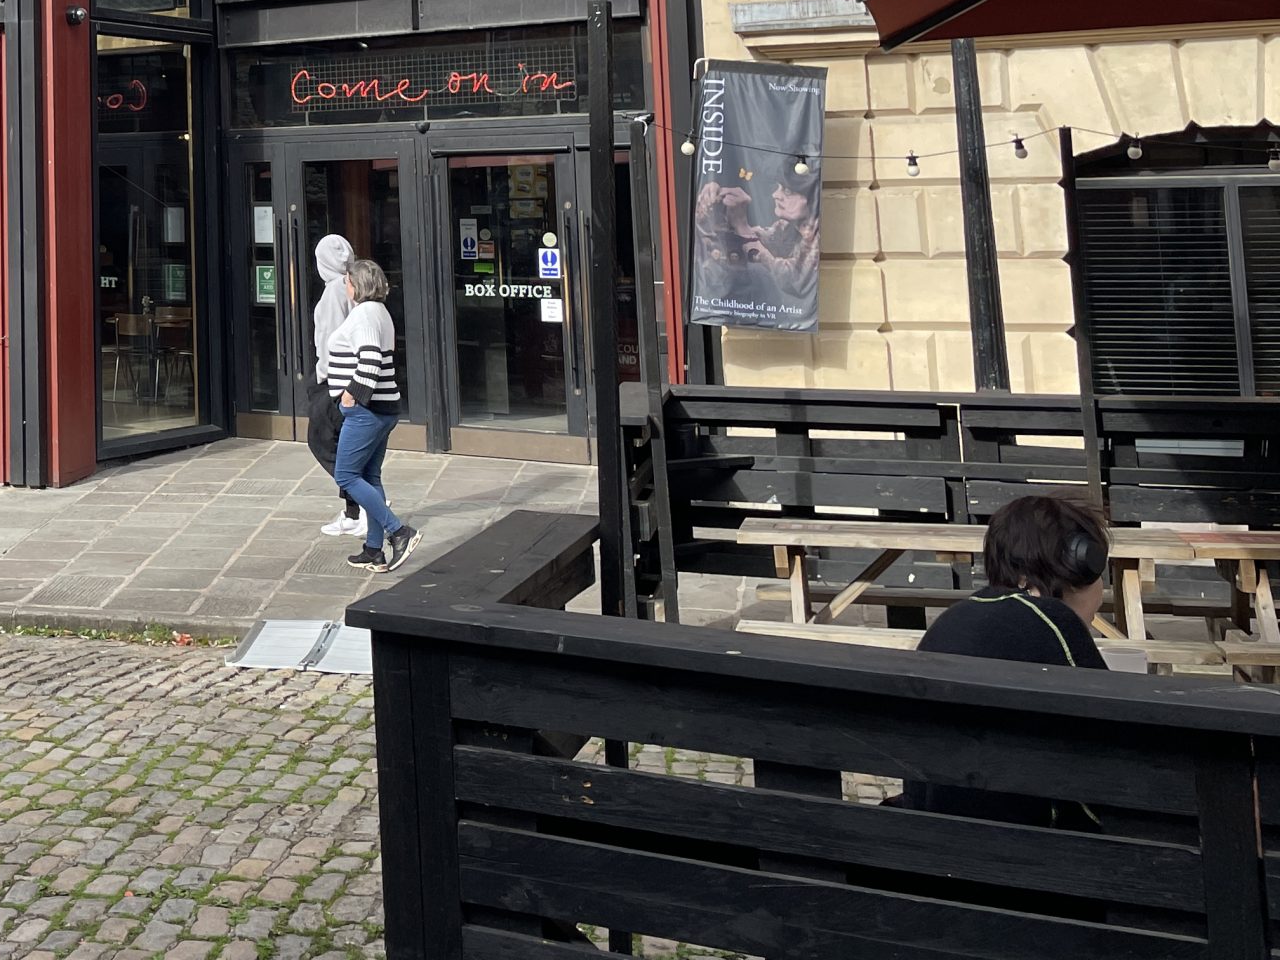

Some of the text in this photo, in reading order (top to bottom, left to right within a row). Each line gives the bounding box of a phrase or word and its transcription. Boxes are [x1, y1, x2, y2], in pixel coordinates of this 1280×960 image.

[290, 62, 575, 104] Come on in
[702, 77, 726, 176] INSIDE
[464, 283, 553, 298] BOX OFFICE
[694, 295, 709, 306] The
[710, 297, 754, 311] Childhood
[756, 302, 766, 311] of
[778, 304, 804, 315] Artist
